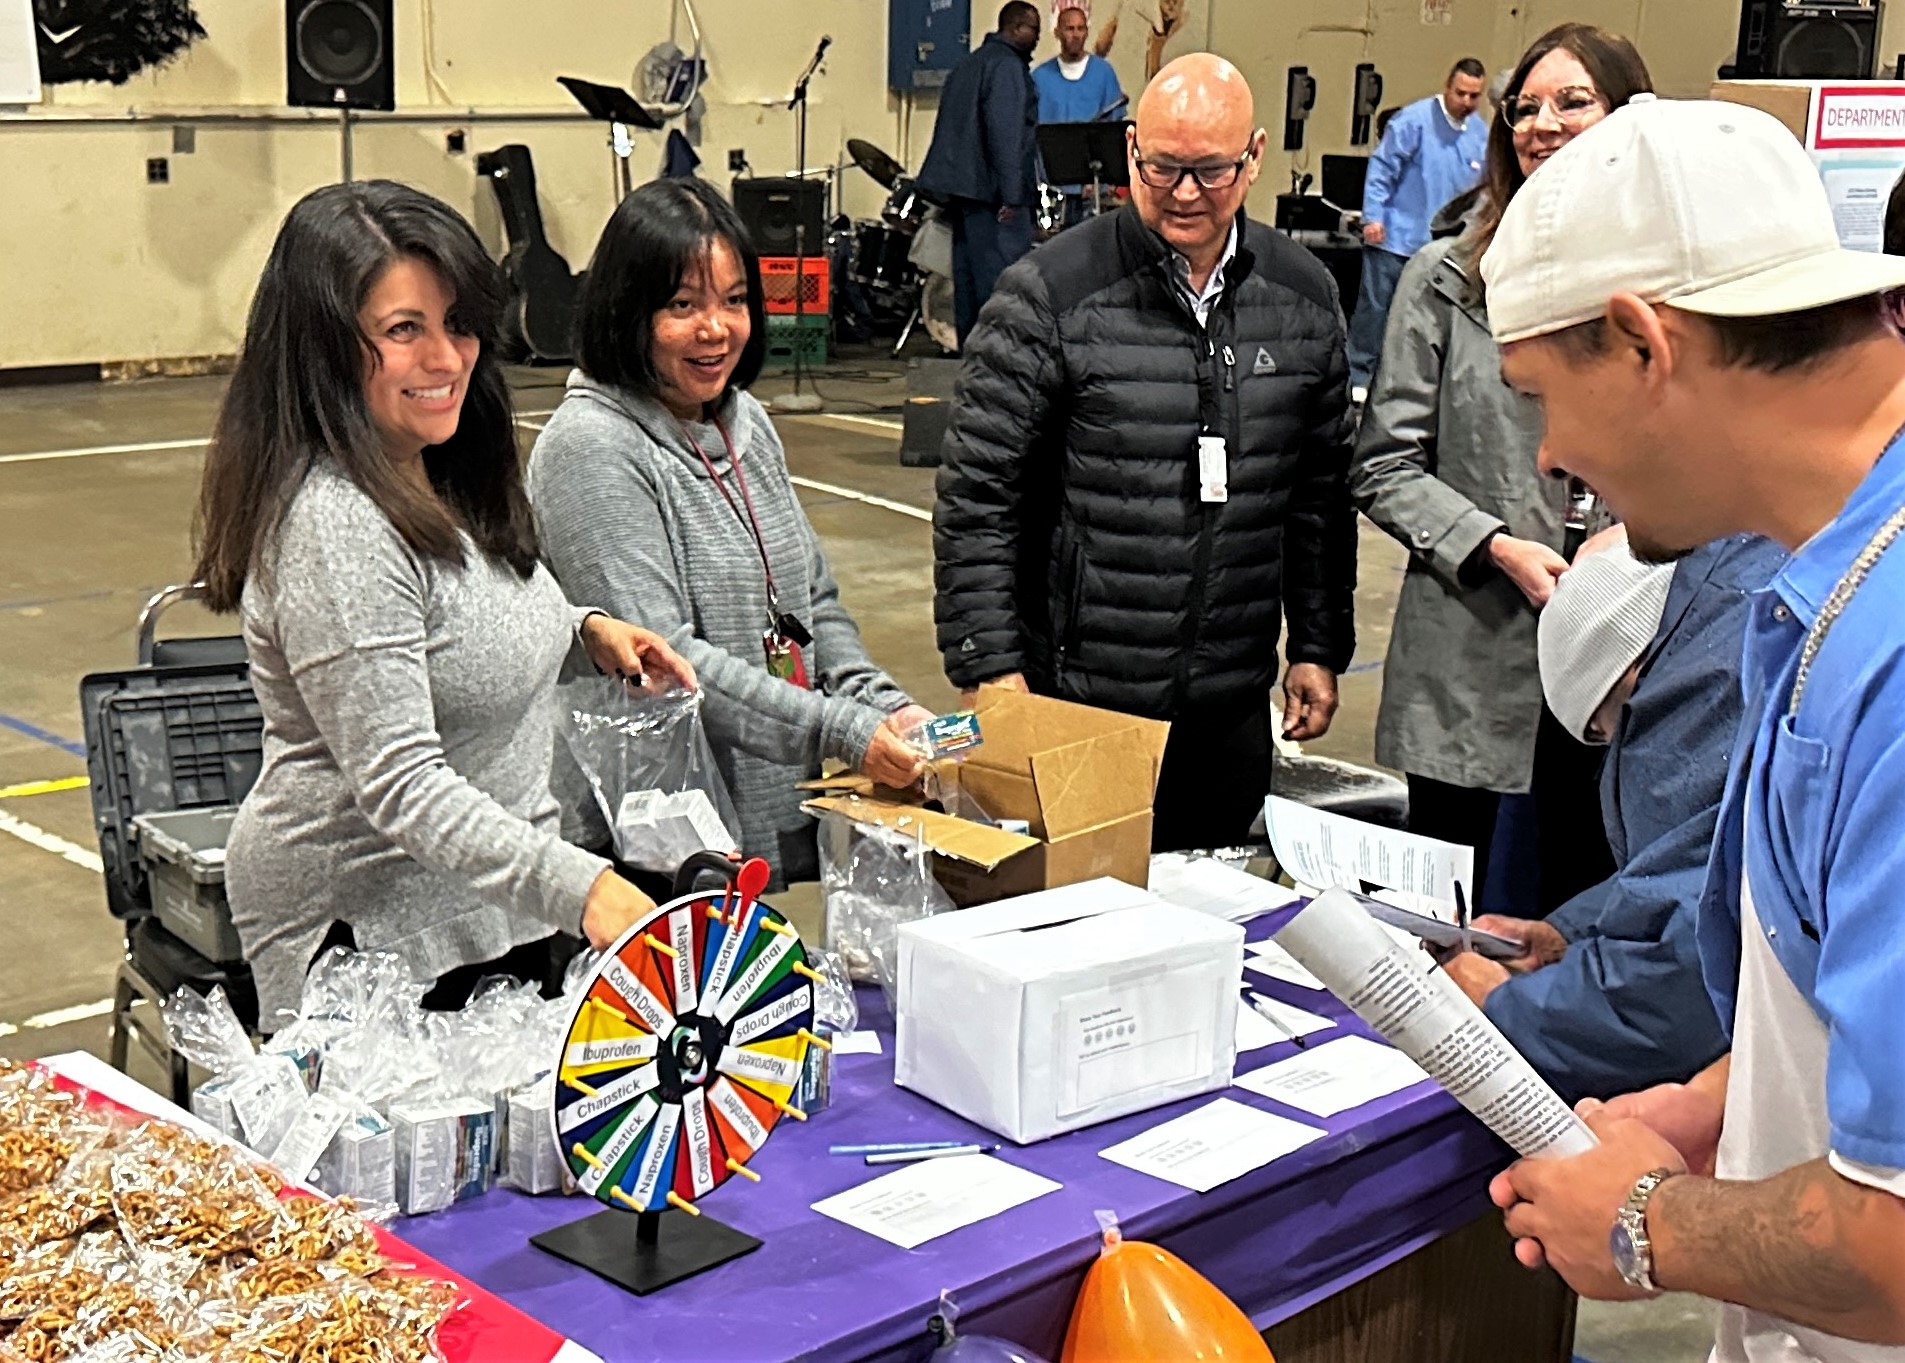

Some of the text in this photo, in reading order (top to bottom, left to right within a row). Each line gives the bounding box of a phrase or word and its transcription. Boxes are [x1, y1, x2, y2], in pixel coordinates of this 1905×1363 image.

[677, 924, 691, 993] Naproxen
[710, 923, 745, 993] hapstick
[733, 943, 782, 1002] Ibuprofen
[609, 967, 665, 1030] Cough Drops
[736, 993, 809, 1039] Cough Drops
[582, 1043, 641, 1062] Ibuprofen
[737, 1054, 787, 1076] Naproxen
[577, 1078, 641, 1118] Chapstick
[724, 1093, 760, 1140] Ibuprofen
[639, 1125, 672, 1193] Naproxen
[691, 1099, 709, 1184] Cough Drops
